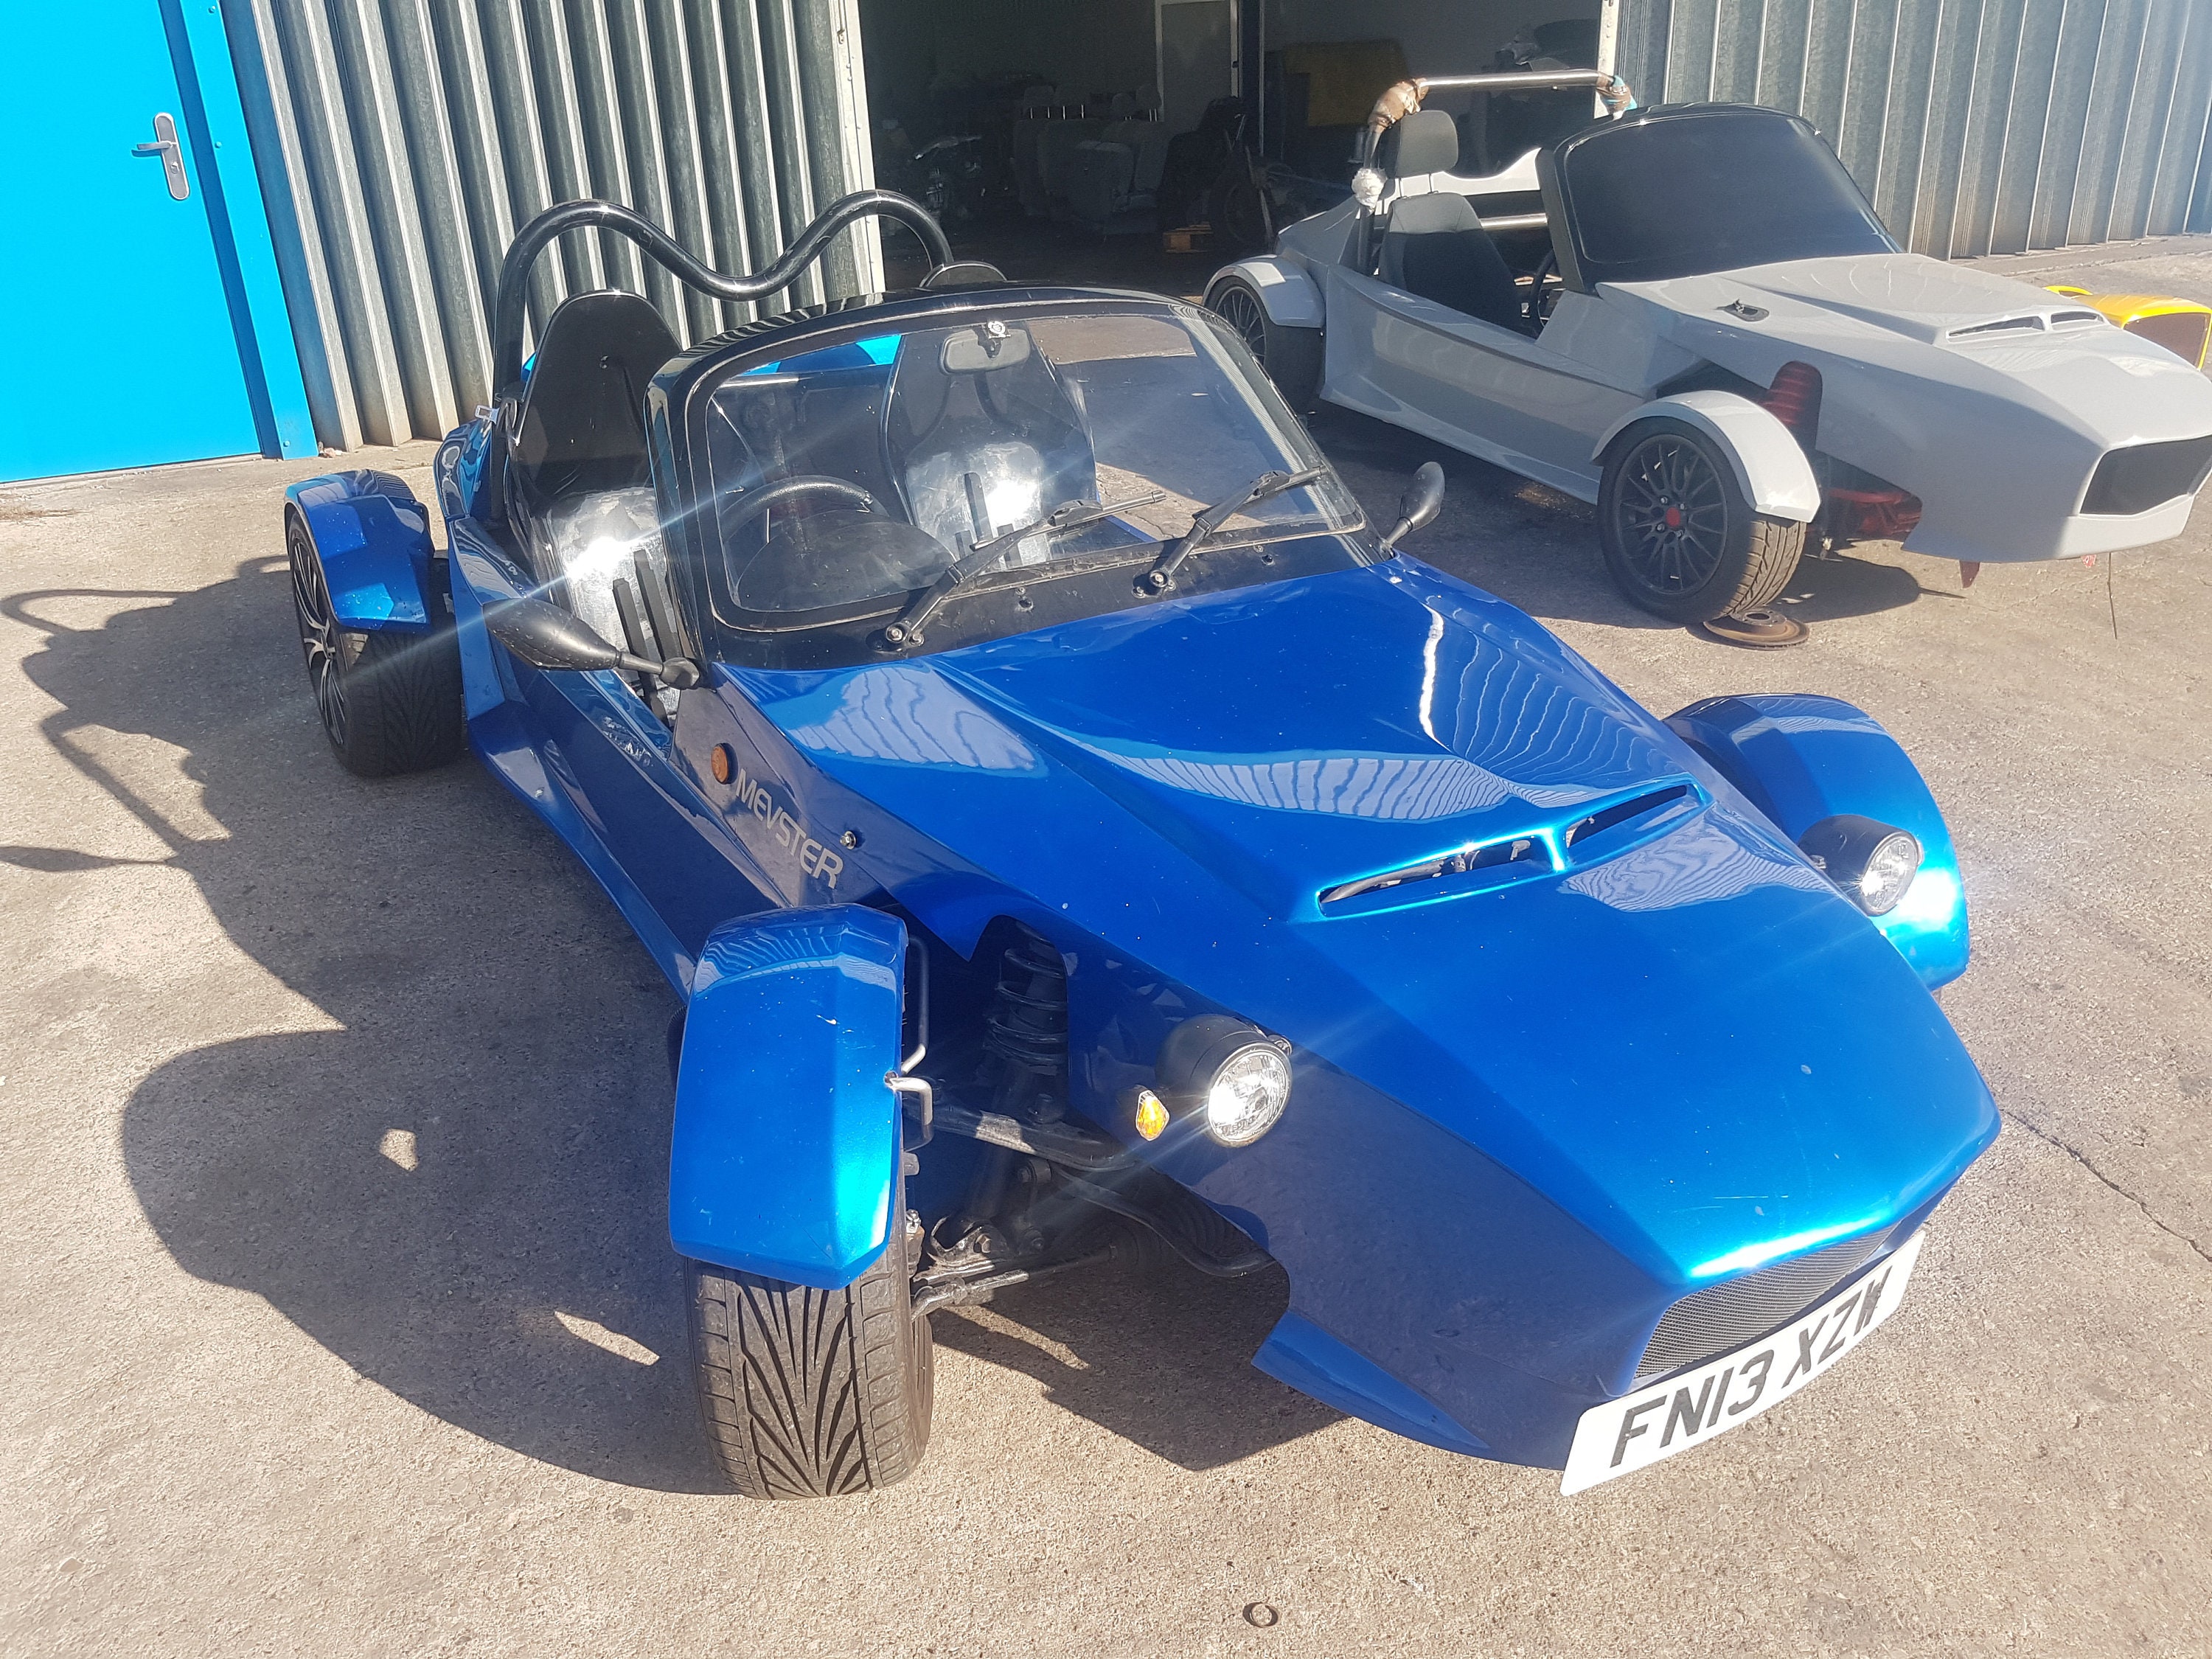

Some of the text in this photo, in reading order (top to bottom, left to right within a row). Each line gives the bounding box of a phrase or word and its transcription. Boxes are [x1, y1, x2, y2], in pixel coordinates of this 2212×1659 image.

[736, 768, 844, 888] MEVSTER
[1610, 1265, 1893, 1468] FN13 XZW
